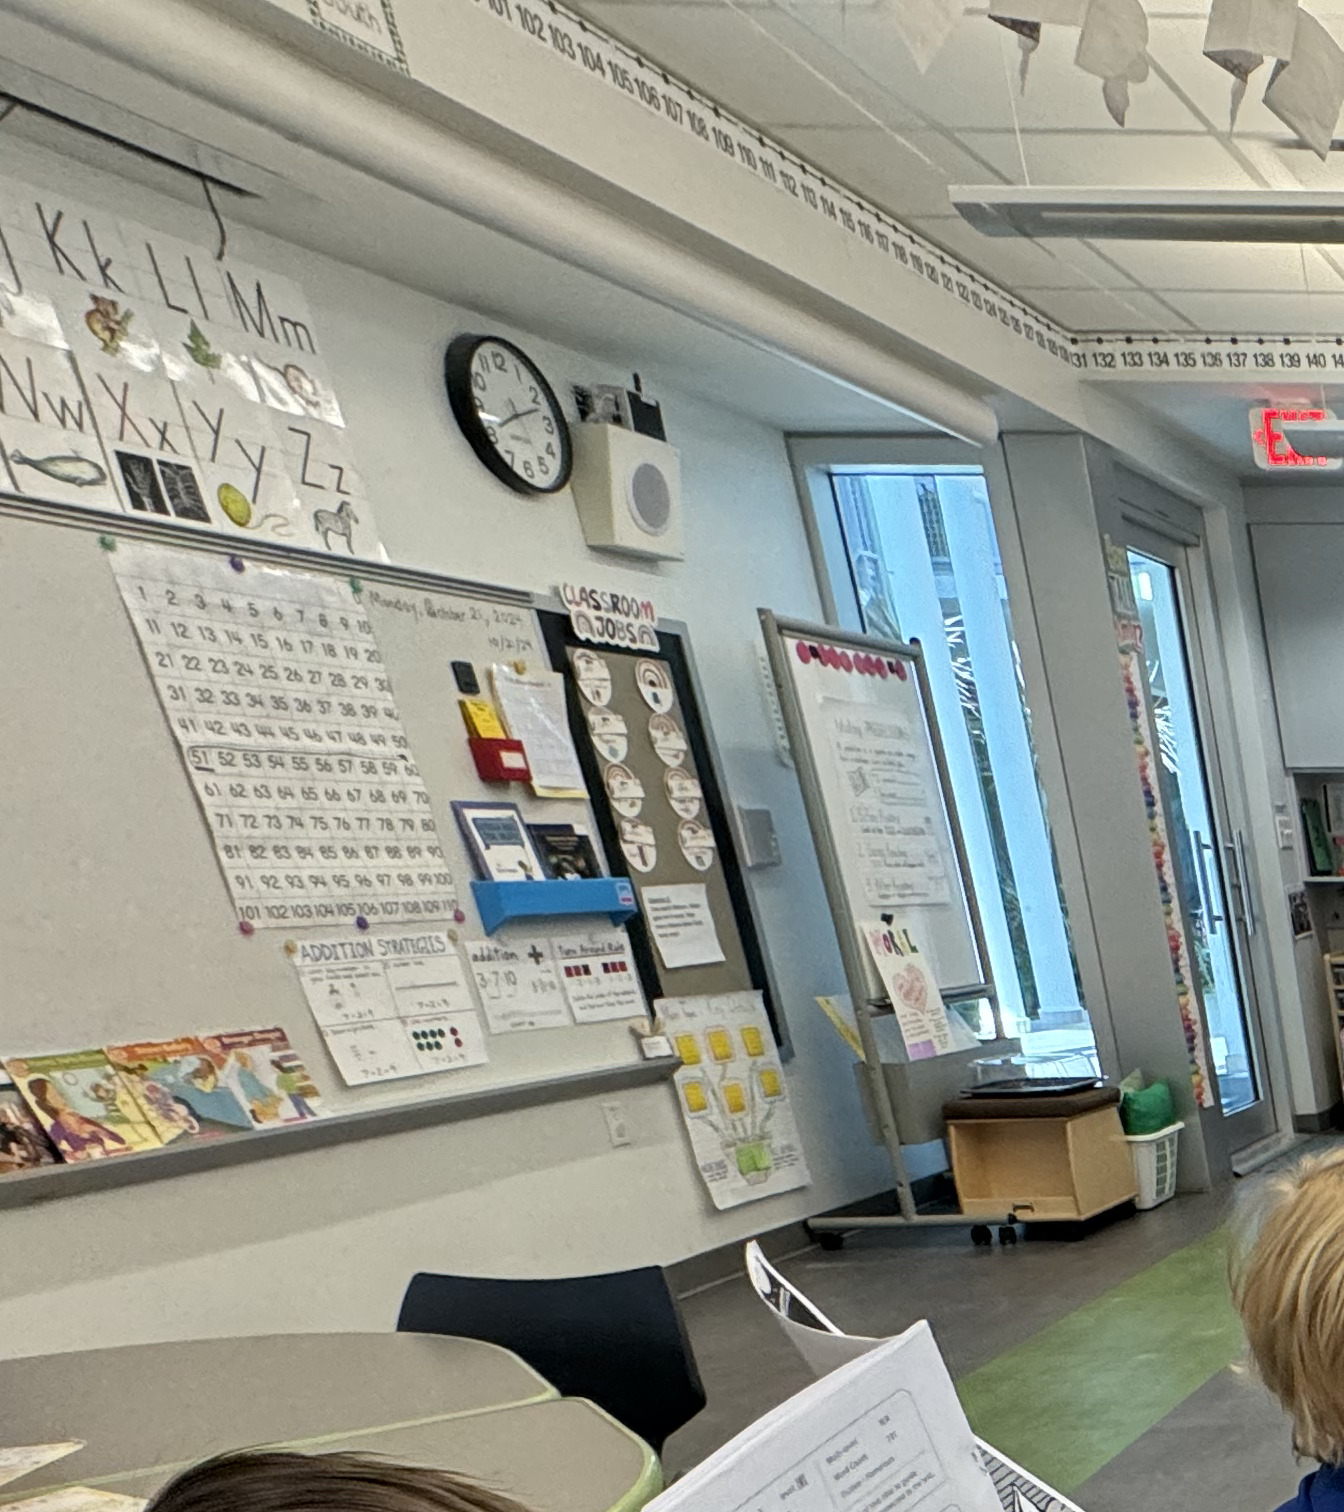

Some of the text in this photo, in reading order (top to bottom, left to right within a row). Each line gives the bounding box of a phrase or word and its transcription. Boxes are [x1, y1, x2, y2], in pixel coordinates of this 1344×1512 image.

[516, 5, 735, 157] 102 104 105 106 107 108 109
[492, 350, 508, 374] 12
[1092, 353, 1116, 368] 132
[1149, 352, 1170, 367] 134
[1173, 353, 1197, 368] 135
[1225, 353, 1248, 368] 137
[1252, 353, 1275, 368] 138
[1278, 353, 1301, 368] 139
[1305, 353, 1326, 368] 140
[514, 364, 523, 384] 1
[528, 387, 541, 406] 2
[542, 415, 554, 435] 3
[545, 442, 557, 459] 4
[523, 460, 535, 479] 6
[538, 456, 550, 475] 5
[562, 582, 655, 624] CLASSROOM
[595, 618, 637, 644] JOBS
[300, 934, 446, 962] ADDITION STRATEGIES
